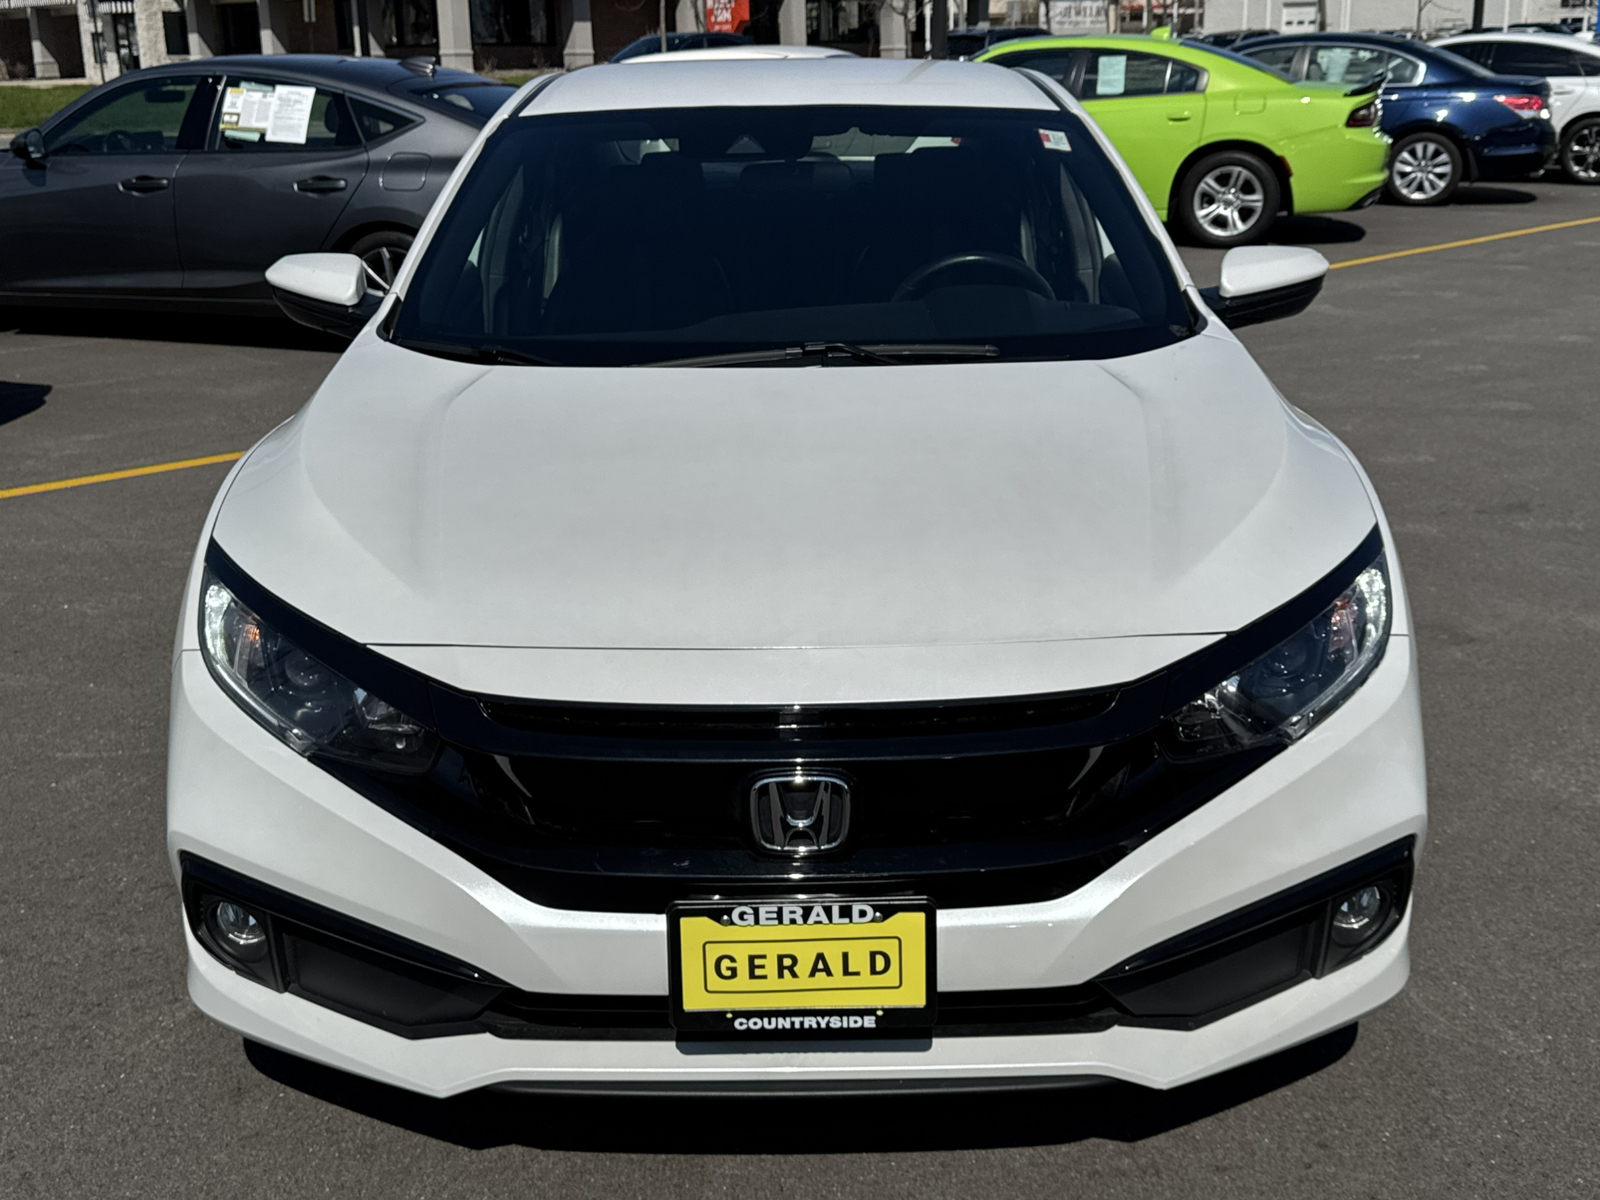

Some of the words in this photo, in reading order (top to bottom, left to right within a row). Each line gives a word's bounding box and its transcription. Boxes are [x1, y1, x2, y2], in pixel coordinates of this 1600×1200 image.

[731, 904, 874, 926] GERALD
[713, 950, 891, 980] GERALD
[733, 1016, 876, 1030] COUNTRYSIDE
